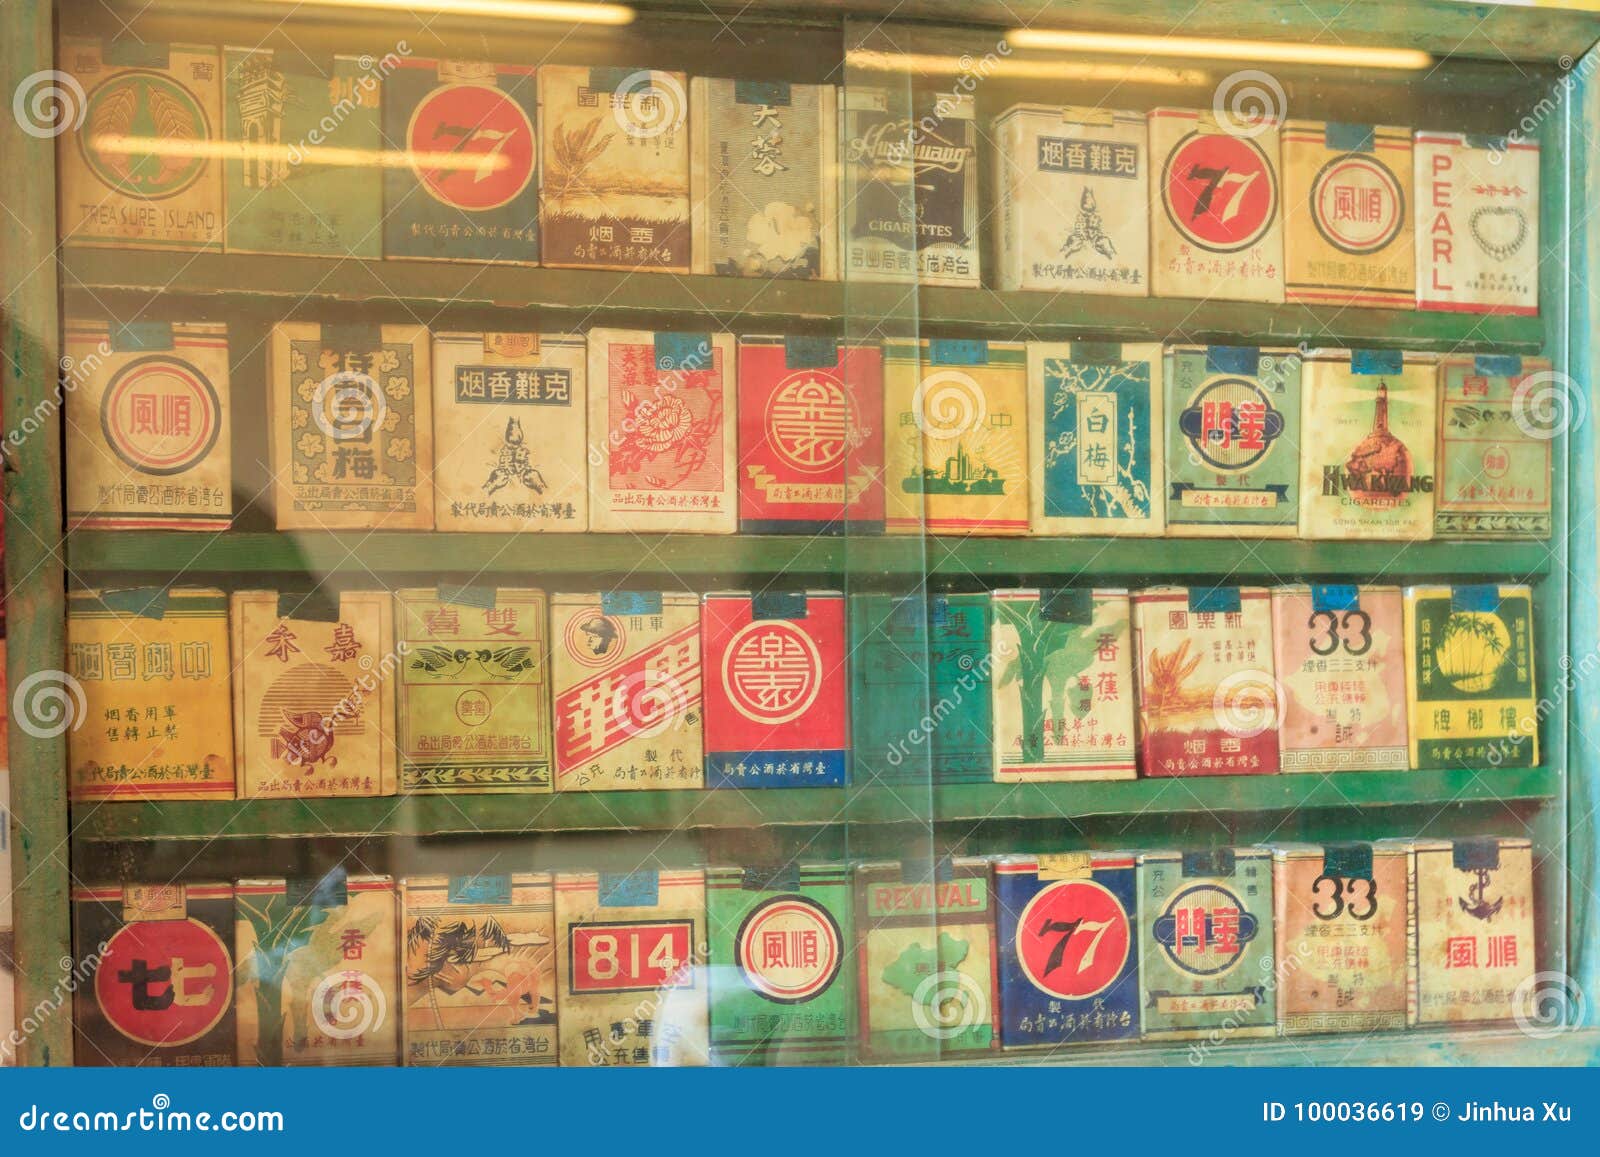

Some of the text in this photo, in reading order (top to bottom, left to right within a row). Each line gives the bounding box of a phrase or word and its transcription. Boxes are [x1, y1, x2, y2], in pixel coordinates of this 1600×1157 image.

[1041, 142, 1137, 174] 克難香烟
[1187, 163, 1260, 222] 77
[1332, 185, 1383, 224] 順風
[79, 203, 216, 230] TREASURE ISLAND
[1431, 154, 1453, 291] PEARL
[460, 371, 568, 400] 克難香烟
[130, 394, 191, 437] 順風
[1083, 406, 1111, 469] 白梅
[424, 606, 522, 636] 雙喜
[1308, 610, 1373, 656] 33
[1093, 633, 1120, 702] 香蕉
[104, 704, 177, 722] 軍用香烟
[875, 883, 981, 911] REVIVAL
[1312, 876, 1377, 921] 33
[587, 934, 680, 979] 814
[762, 930, 818, 969] 順風
[1038, 917, 1117, 978] 77
[1445, 935, 1518, 969] 順風
